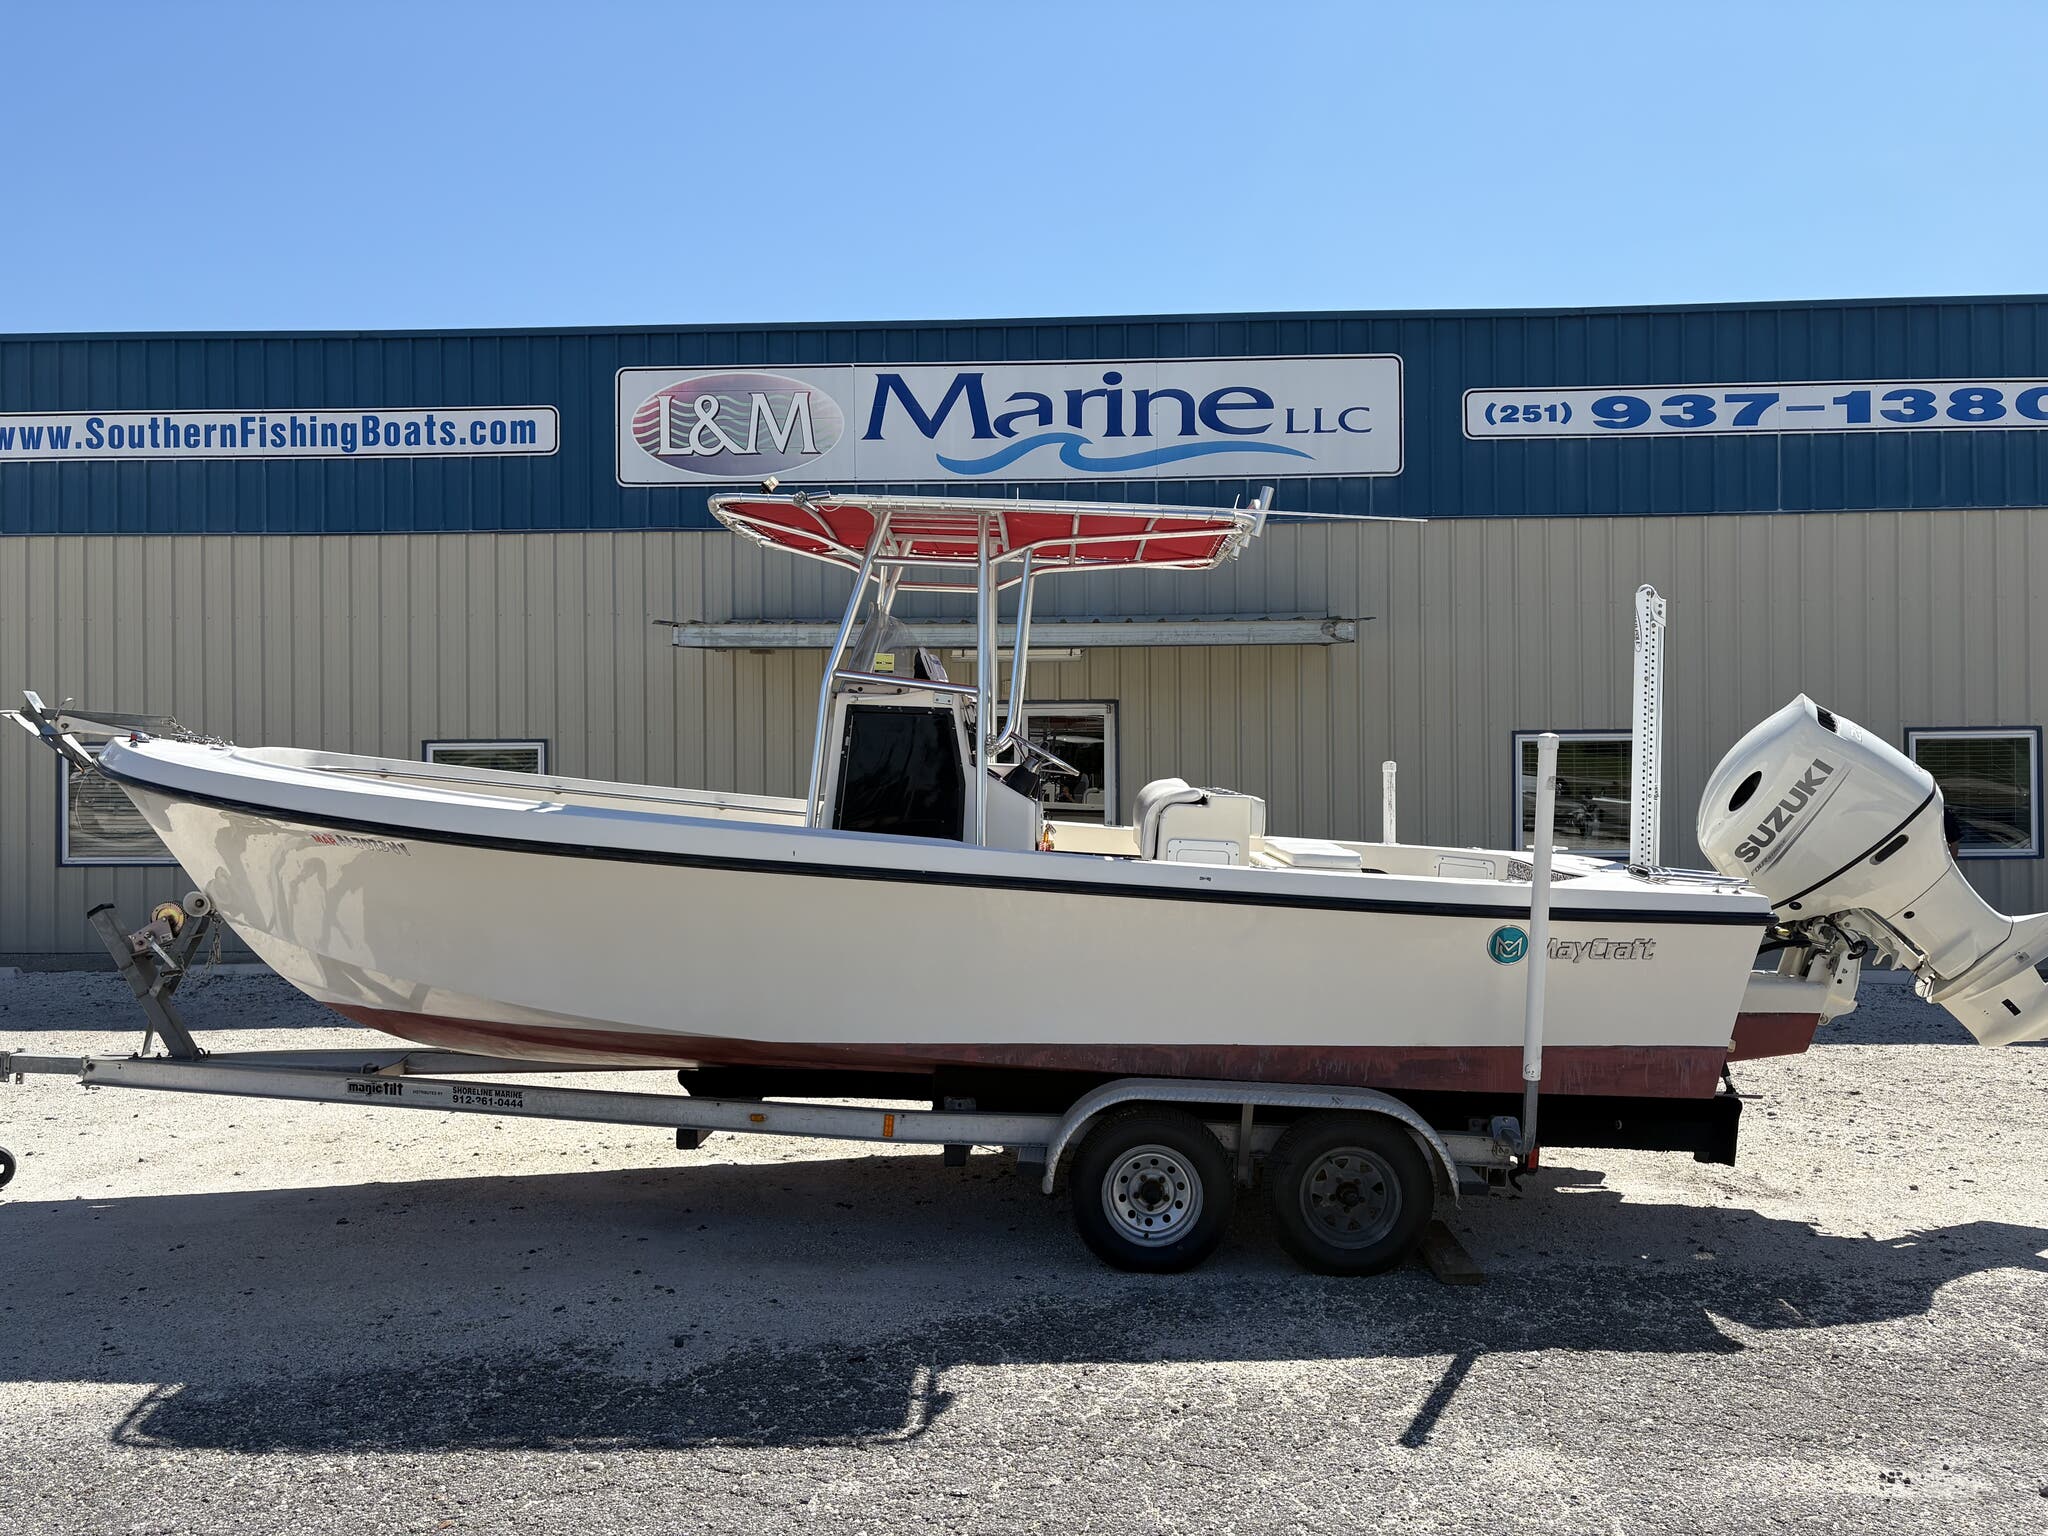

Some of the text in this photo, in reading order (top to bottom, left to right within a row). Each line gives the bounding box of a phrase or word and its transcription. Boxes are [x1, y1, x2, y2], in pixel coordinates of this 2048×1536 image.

[656, 371, 1373, 457] L&M Marine LLC
[1485, 402, 1573, 426] (251)
[1735, 758, 1834, 863] SUZUKI
[452, 1086, 523, 1099] SHORELINE MARINE
